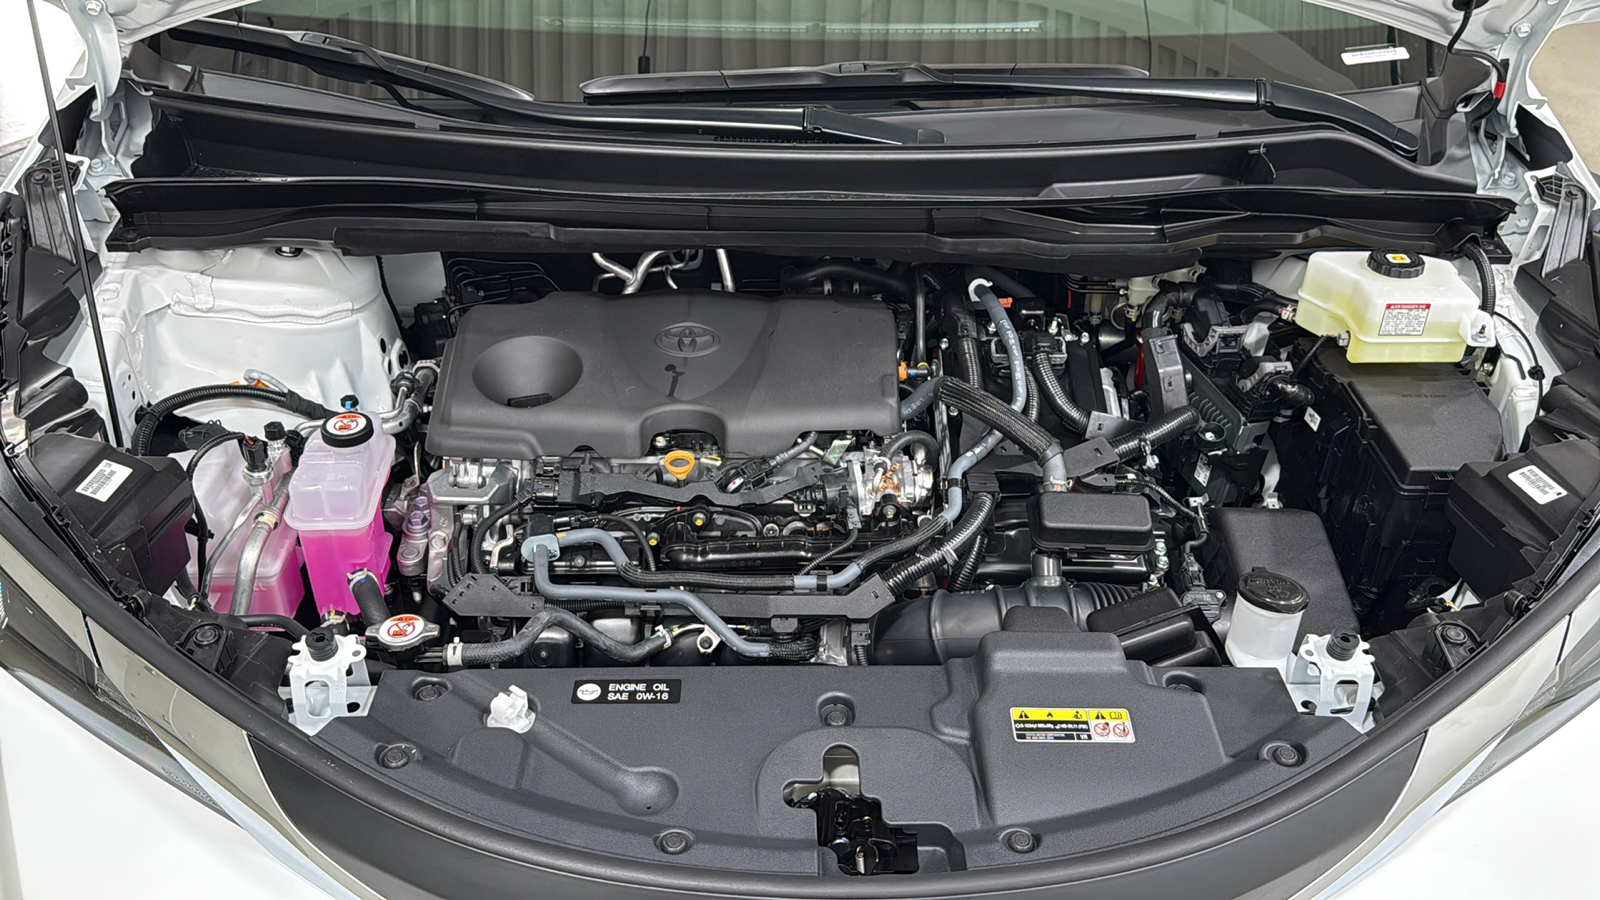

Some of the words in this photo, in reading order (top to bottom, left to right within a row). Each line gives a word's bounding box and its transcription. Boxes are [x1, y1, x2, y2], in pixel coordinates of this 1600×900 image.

[608, 683, 647, 692] ENGINE
[652, 683, 670, 691] OIL
[607, 692, 629, 700] SAE
[635, 692, 669, 700] 0W-16
